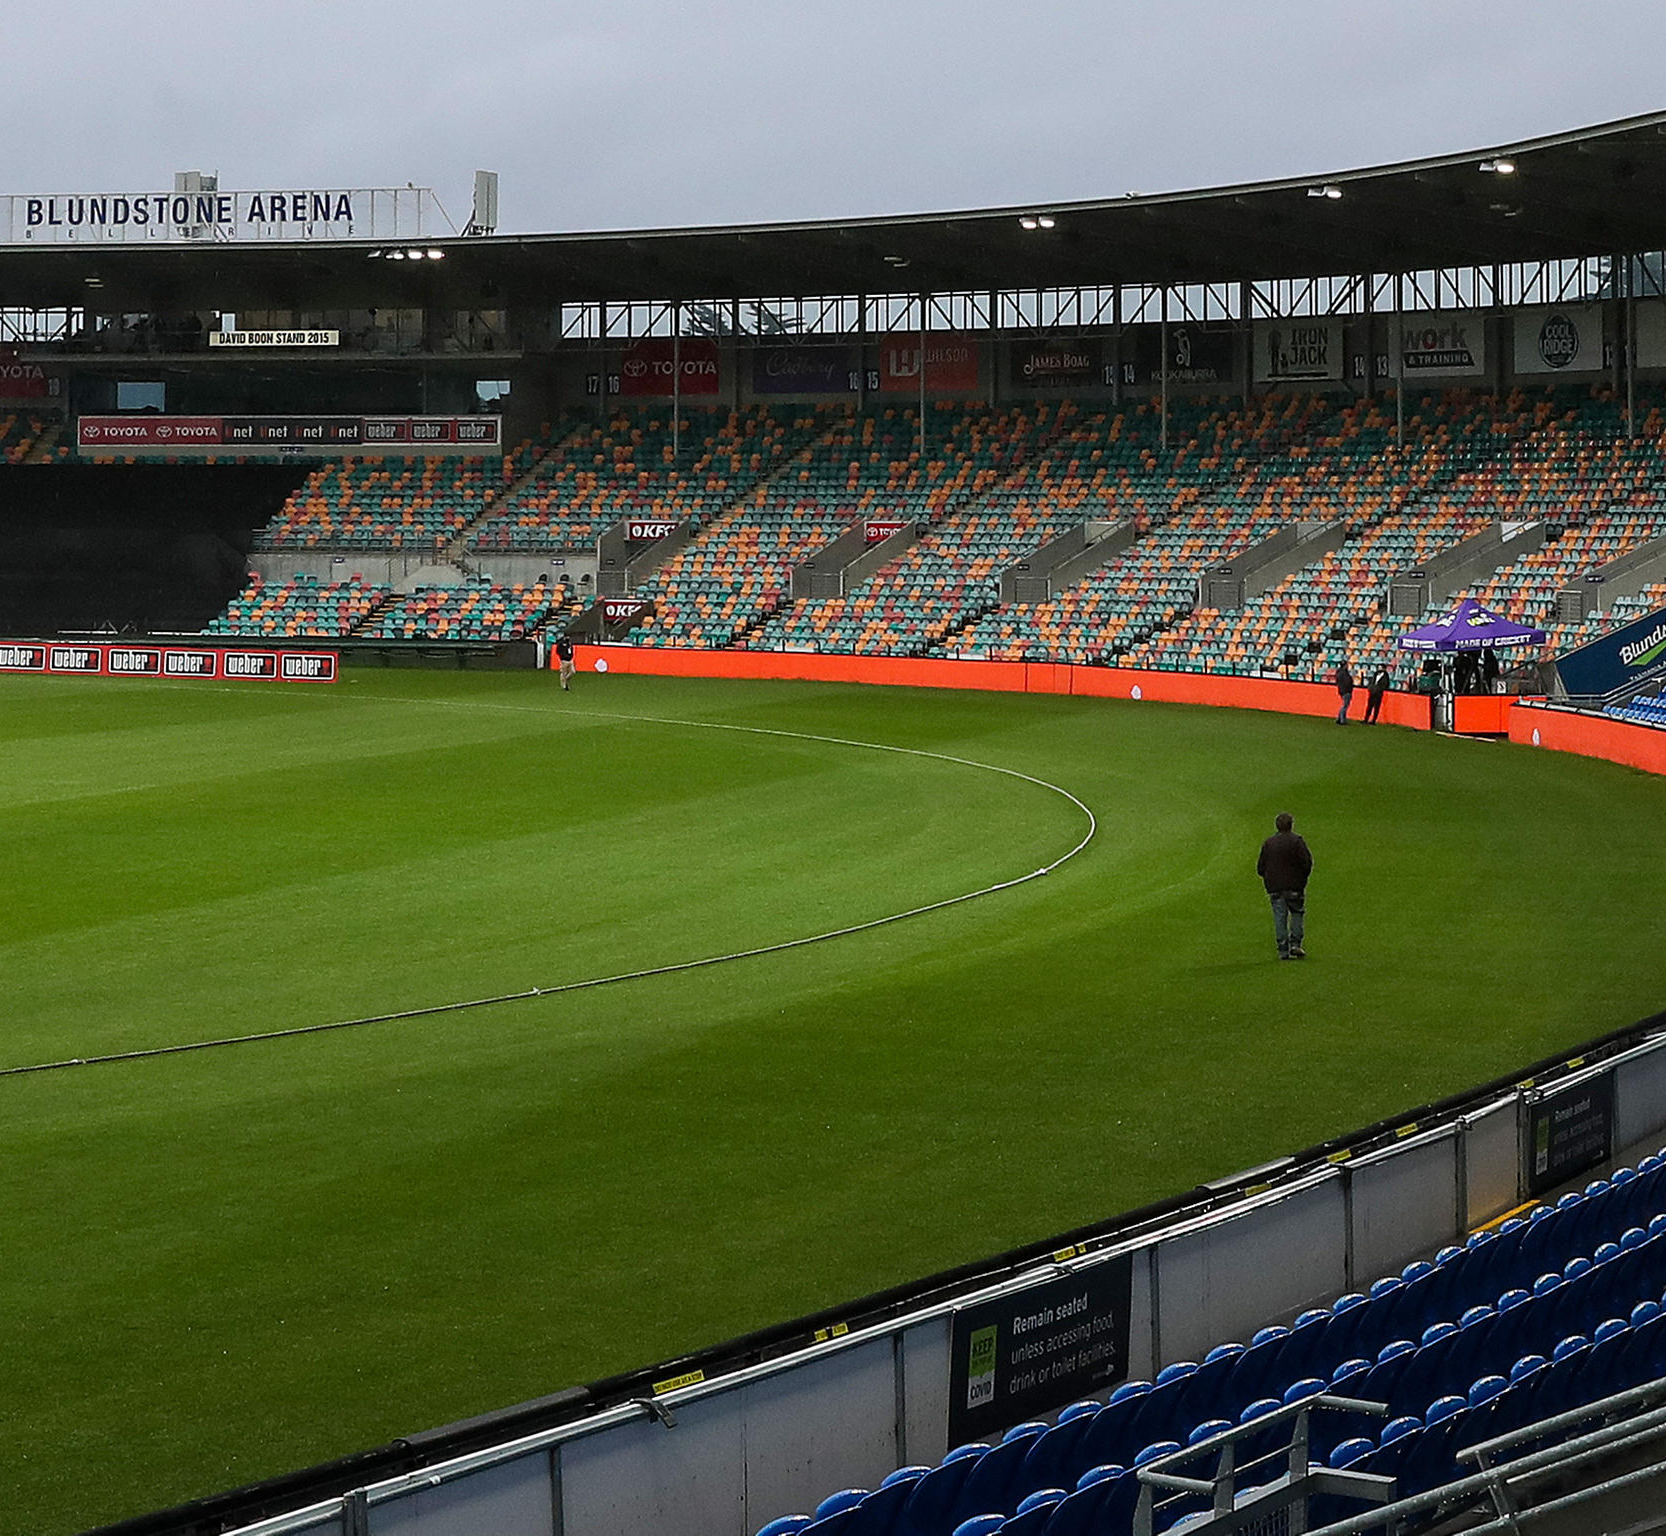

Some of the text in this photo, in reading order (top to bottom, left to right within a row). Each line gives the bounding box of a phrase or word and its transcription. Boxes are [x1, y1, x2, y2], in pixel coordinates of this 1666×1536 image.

[27, 194, 354, 226] BLUNDSTONE ARENA
[219, 332, 329, 344] DAVID BOON STAND 2015
[1290, 328, 1328, 346] IRON
[1545, 325, 1570, 338] COOL
[1291, 346, 1327, 365] JACK
[1543, 339, 1574, 355] RIDGE
[653, 360, 717, 375] TOYOTA
[1418, 353, 1469, 364] TRAINING
[867, 372, 878, 390] 15
[103, 427, 148, 437] TOYOTA
[175, 427, 218, 437] TOYOTA
[368, 424, 396, 439] weber
[413, 423, 441, 438] weber
[459, 423, 486, 438] weber
[1482, 637, 1494, 647] OF
[1495, 634, 1532, 646] CRICKET
[53, 649, 88, 669] weber
[113, 650, 148, 670] weber
[168, 651, 203, 671] weber
[228, 653, 264, 674] weber
[285, 655, 321, 676] weber
[1013, 1292, 1088, 1335] Remain seated
[972, 1336, 994, 1356] KEEP
[1011, 1340, 1044, 1364] unless
[1046, 1321, 1091, 1353] accessing
[1009, 1371, 1036, 1395] drink
[1038, 1365, 1051, 1383] or
[1052, 1354, 1076, 1379] toilet
[970, 1381, 992, 1400] COVID
